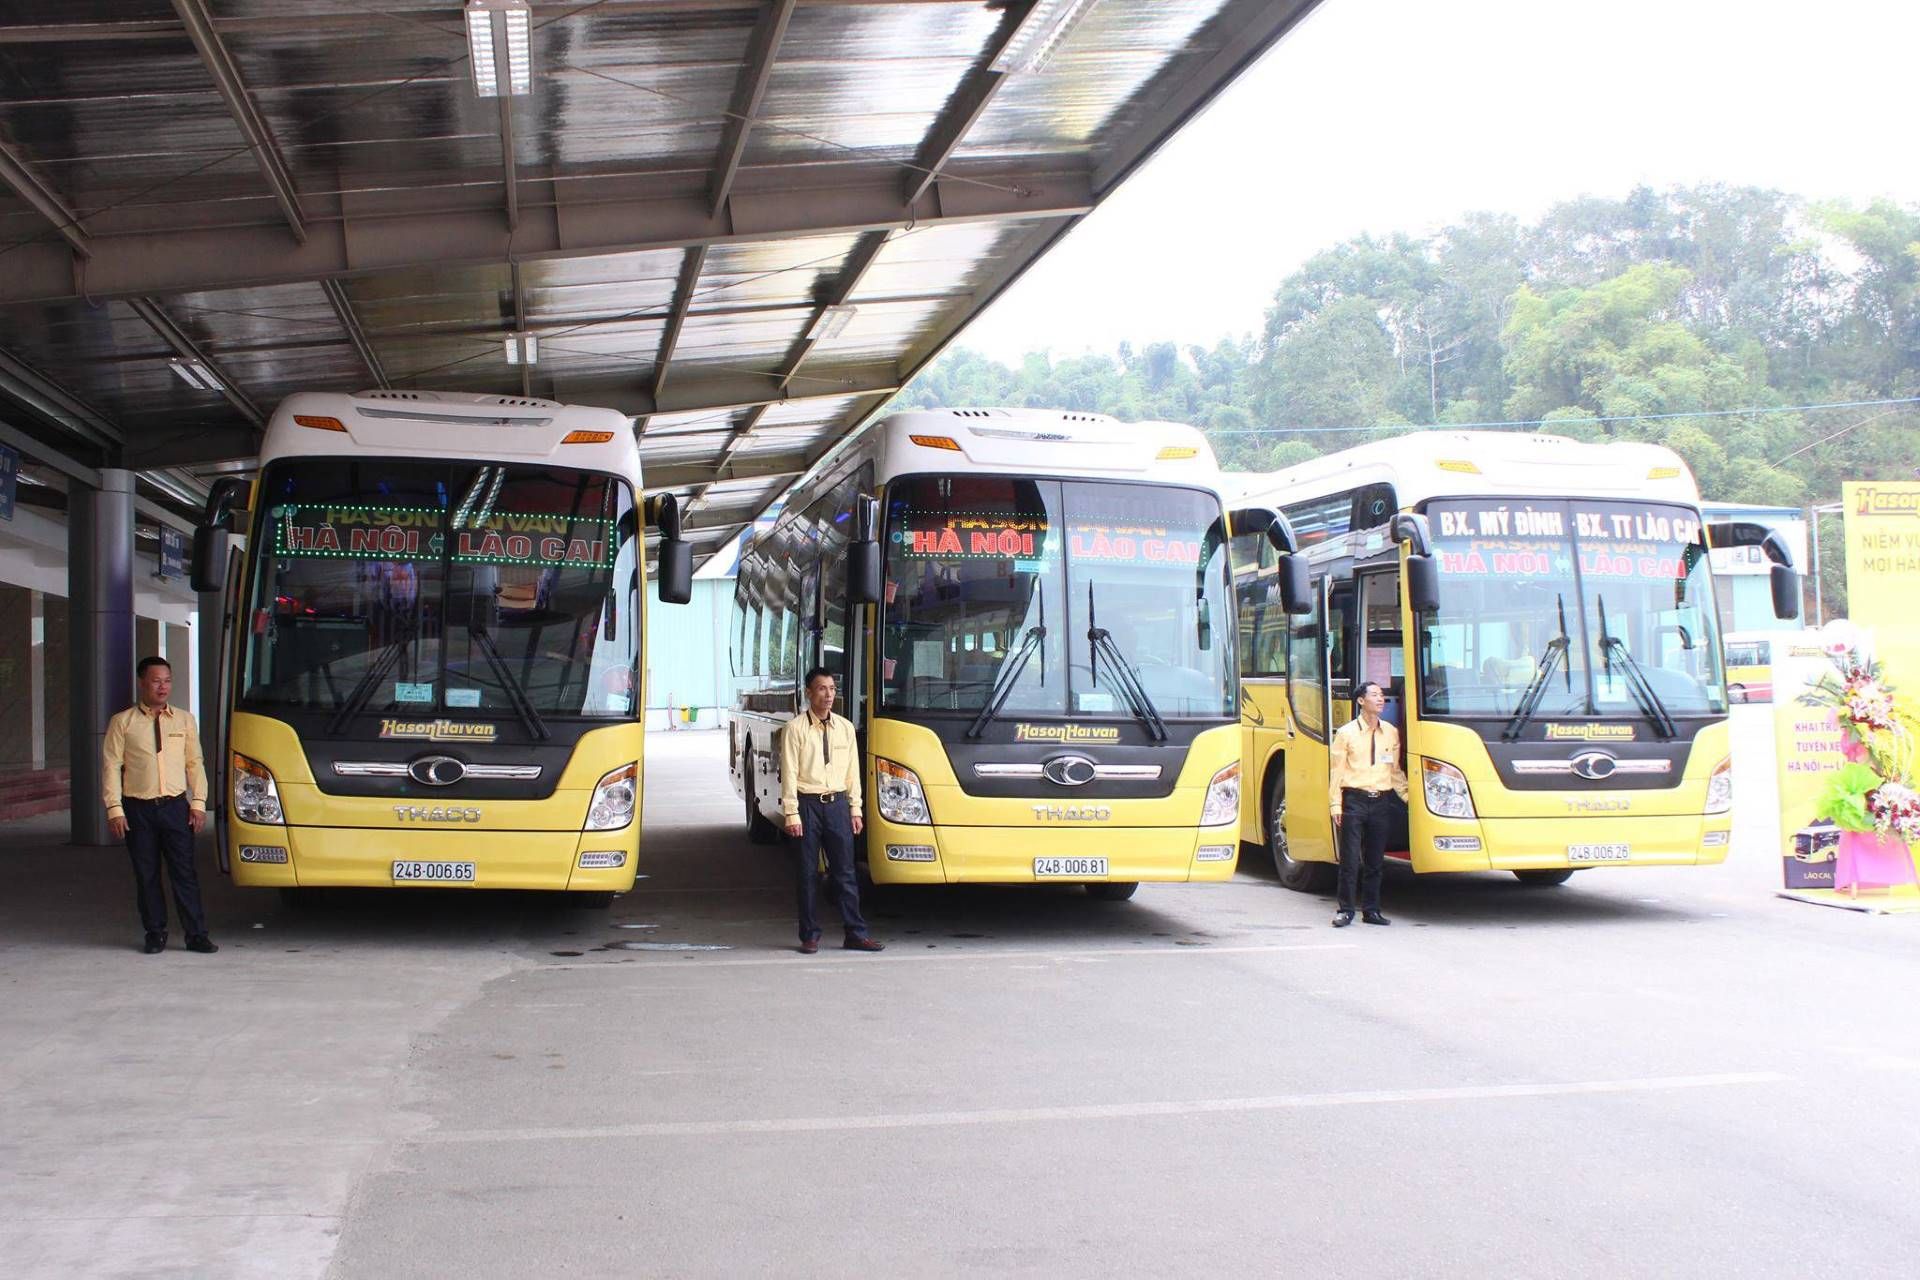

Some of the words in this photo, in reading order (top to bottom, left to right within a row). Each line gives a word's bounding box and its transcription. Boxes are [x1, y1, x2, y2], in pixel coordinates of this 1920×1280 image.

[1440, 512, 1475, 536] BX.
[1576, 513, 1608, 538] BX.
[1611, 515, 1632, 539] TT
[287, 522, 341, 551] HÀ
[459, 529, 532, 559] LÀO
[541, 537, 603, 563] CAI
[912, 527, 963, 554] HÀ
[971, 528, 1034, 557] NỘI
[1142, 539, 1200, 562] CAI
[393, 806, 480, 822] THACO
[1032, 804, 1110, 821] THACO
[395, 863, 472, 878] 24B-006.65
